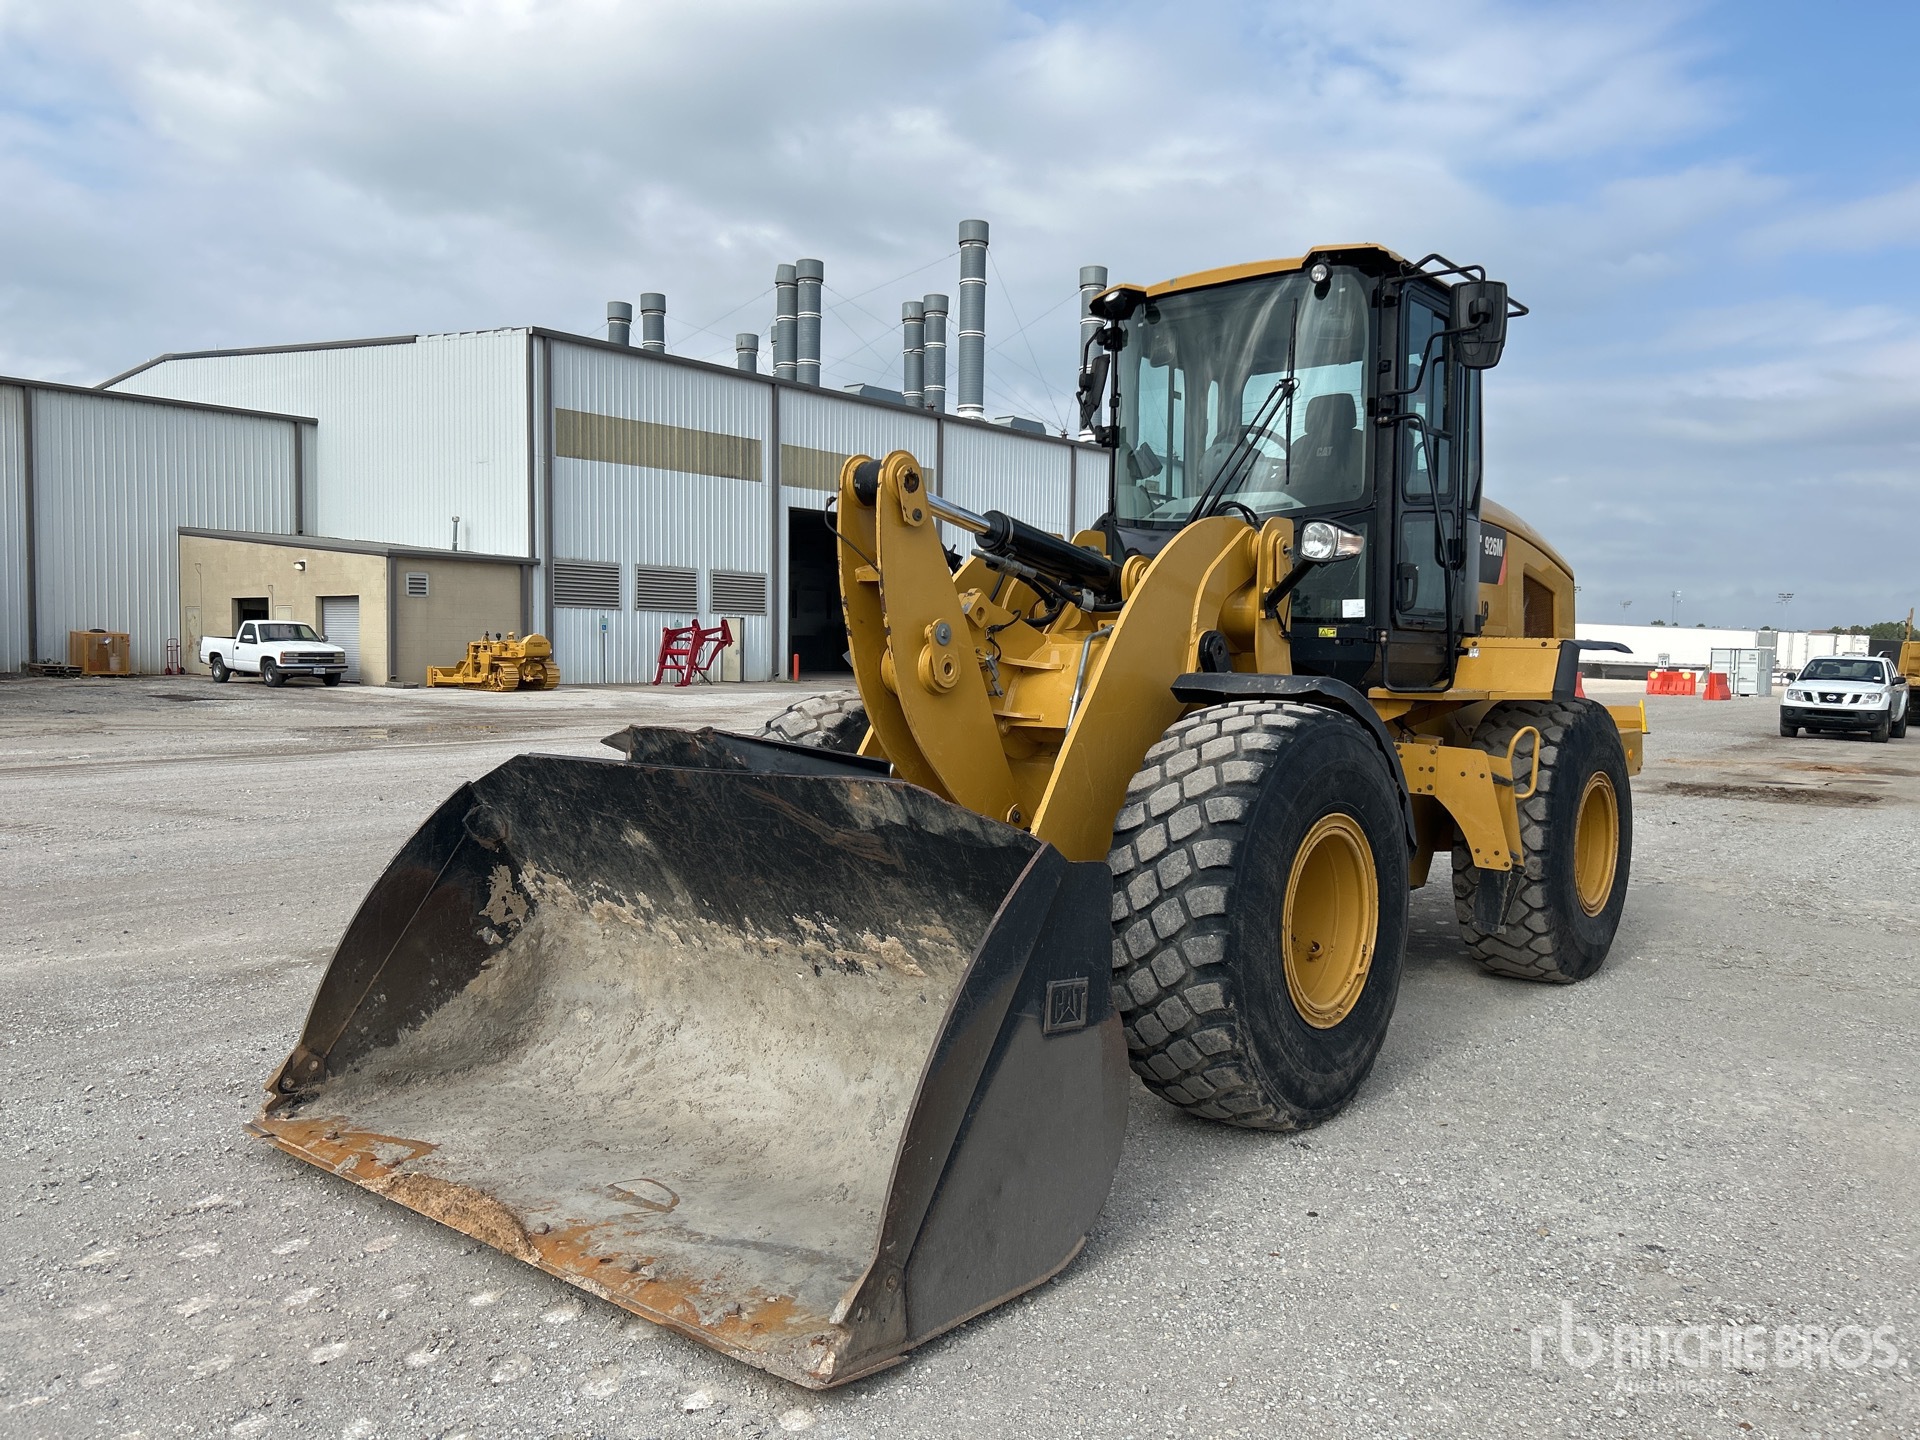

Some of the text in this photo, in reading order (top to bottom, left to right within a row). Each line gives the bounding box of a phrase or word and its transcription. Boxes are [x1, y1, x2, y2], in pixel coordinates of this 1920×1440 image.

[1316, 446, 1333, 457] CAT
[1485, 536, 1503, 557] 926M
[1051, 985, 1086, 1025] CAT
